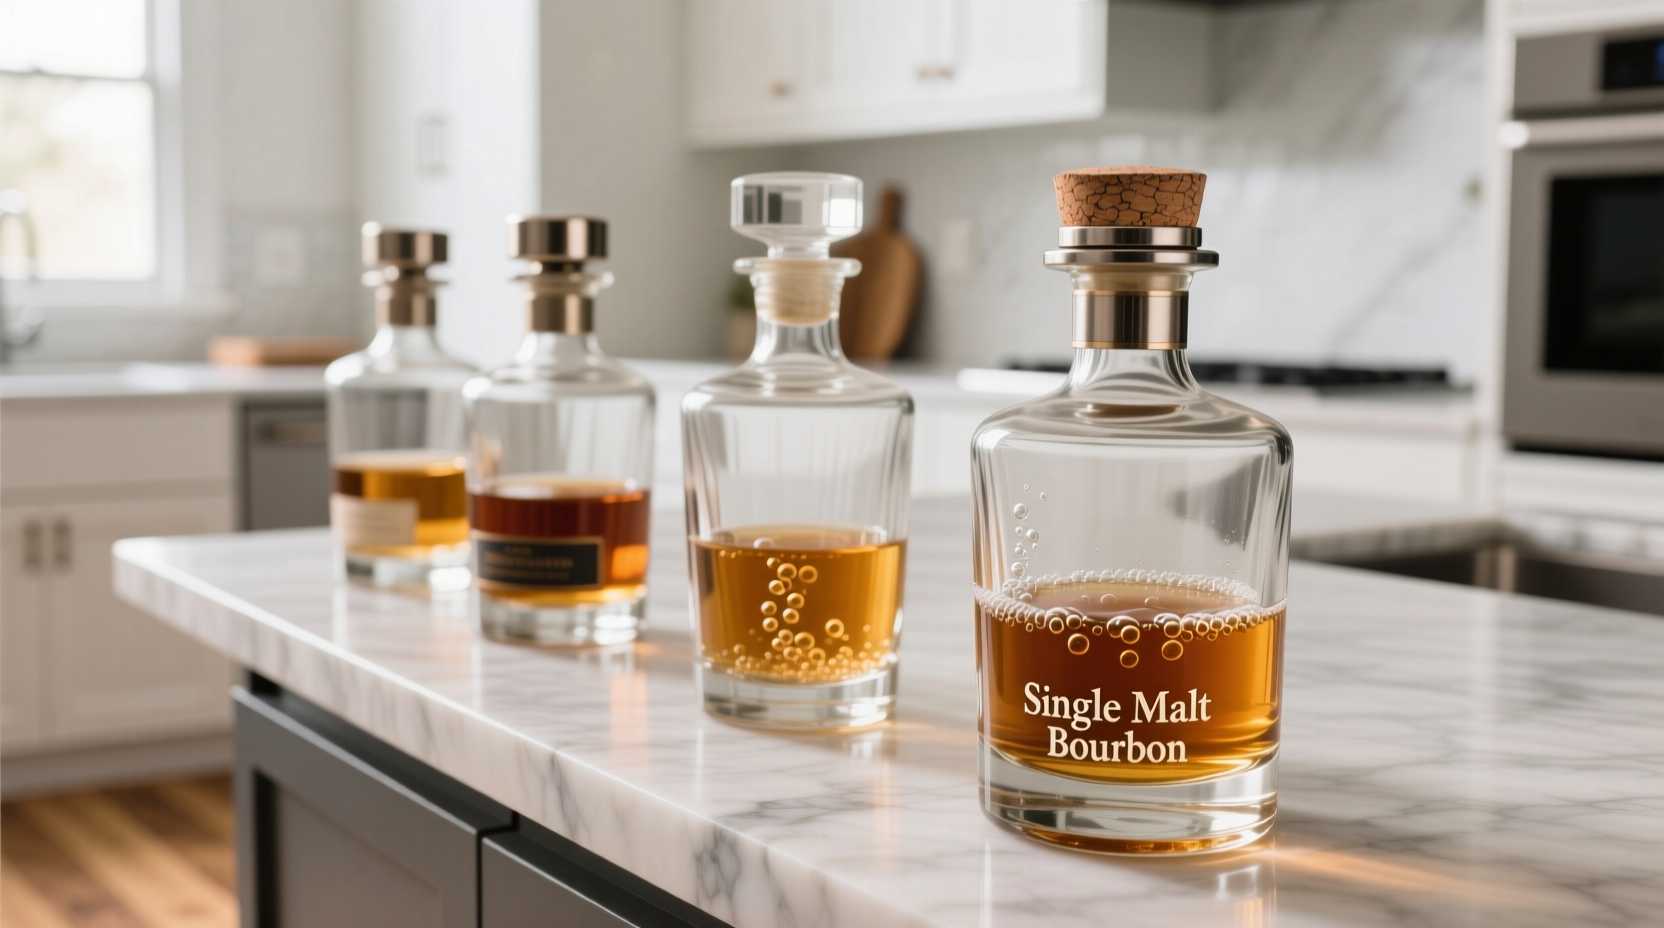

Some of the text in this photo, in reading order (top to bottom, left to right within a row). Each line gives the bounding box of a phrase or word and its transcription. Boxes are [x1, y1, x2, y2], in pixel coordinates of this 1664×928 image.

[1024, 682, 1212, 731] Single Malt
[1047, 725, 1188, 763] Bourbon
